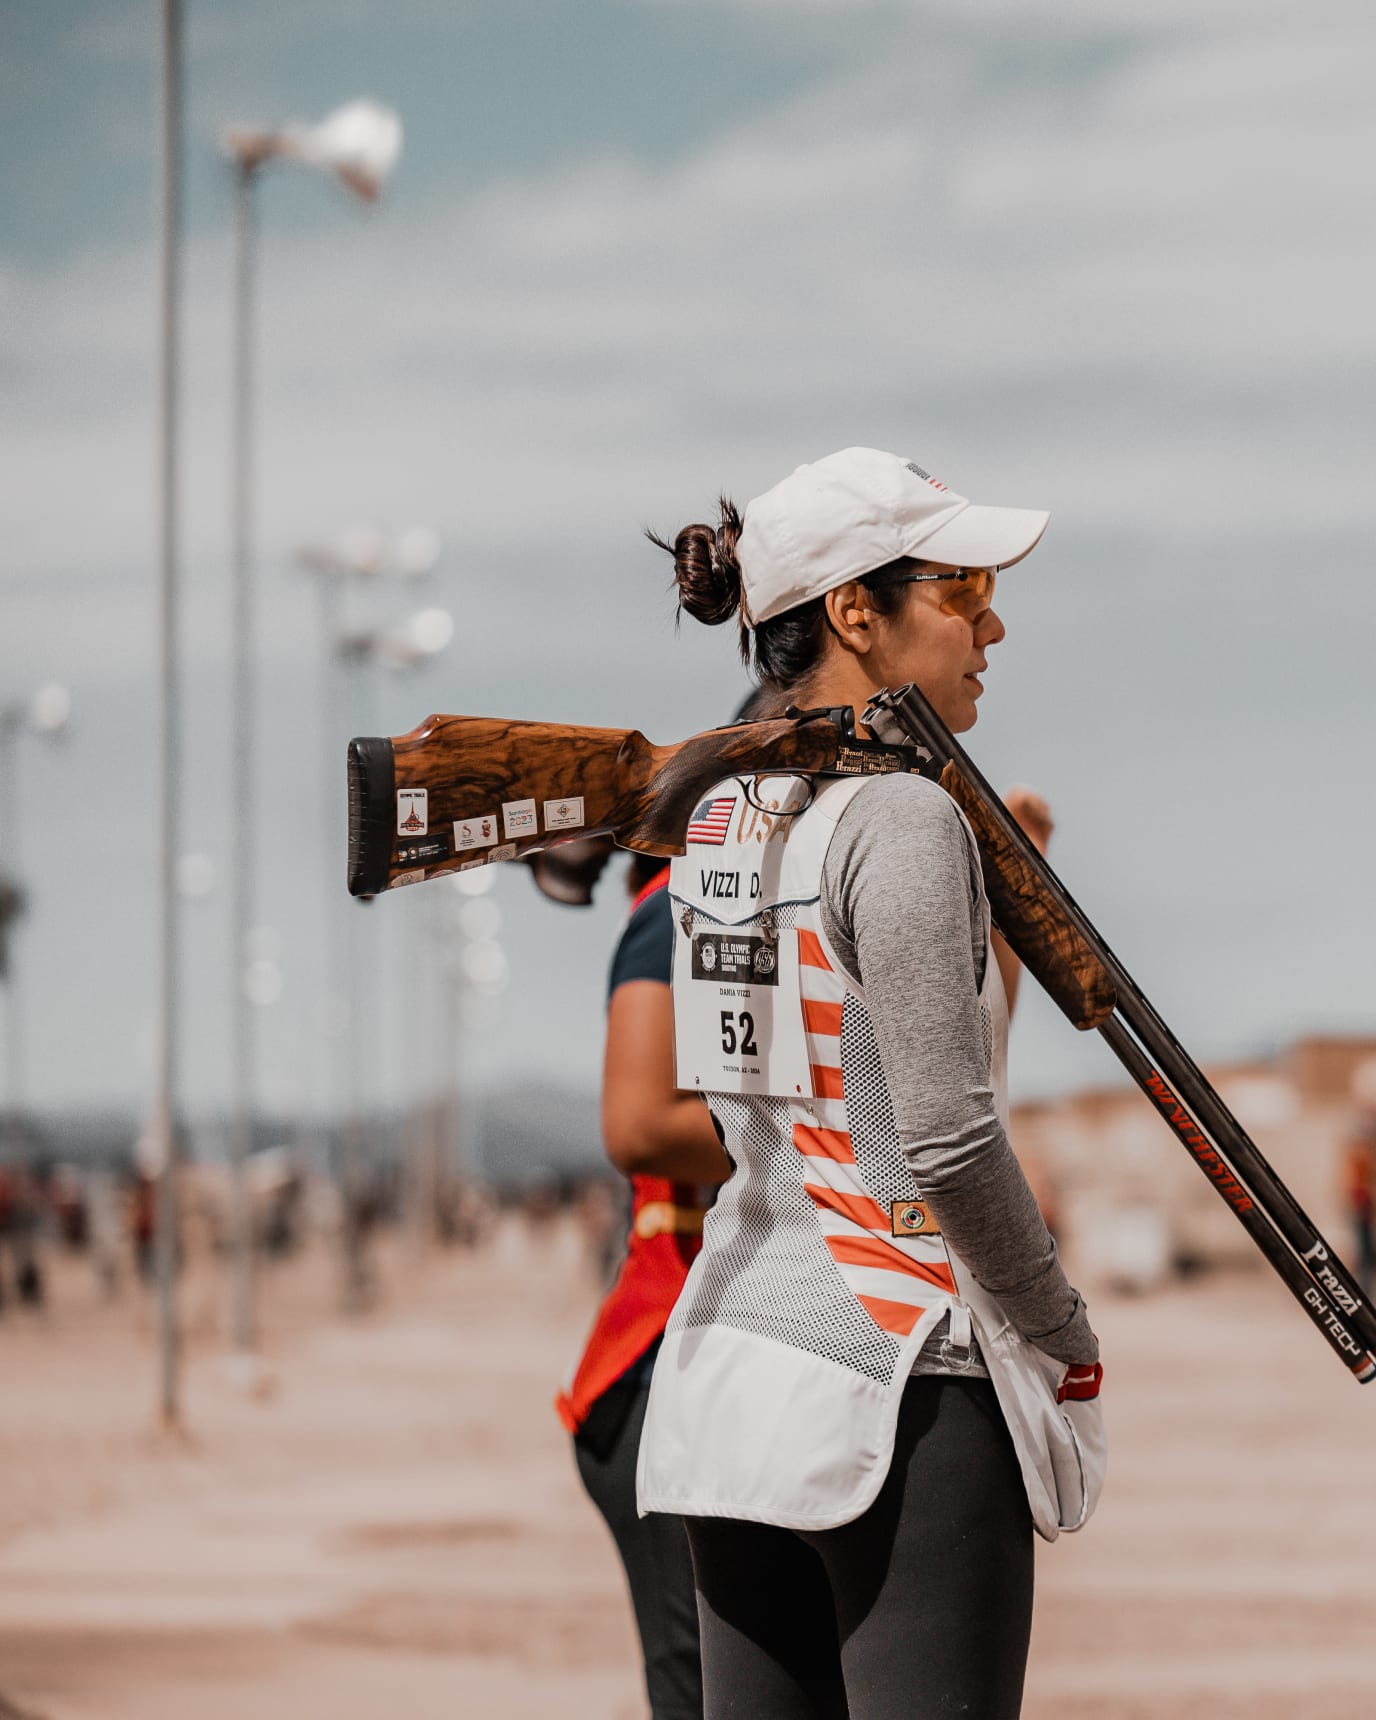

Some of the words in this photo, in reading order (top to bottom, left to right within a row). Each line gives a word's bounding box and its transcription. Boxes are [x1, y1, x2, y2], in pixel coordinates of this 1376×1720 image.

[836, 760, 862, 773] Perazzi
[509, 814, 533, 827] 2023
[737, 799, 801, 845] USA
[701, 869, 740, 898] VIZZI
[750, 872, 762, 898] D.
[730, 943, 751, 954] OLYMPIC
[721, 953, 734, 964] TEAM
[734, 954, 751, 966] TRIALS
[720, 988, 736, 997] DANIA
[737, 990, 751, 998] VIZZI
[721, 1010, 758, 1056] 52
[1300, 1240, 1363, 1317] Prazzi
[1304, 1287, 1328, 1314] GH
[1324, 1311, 1361, 1356] TECH
